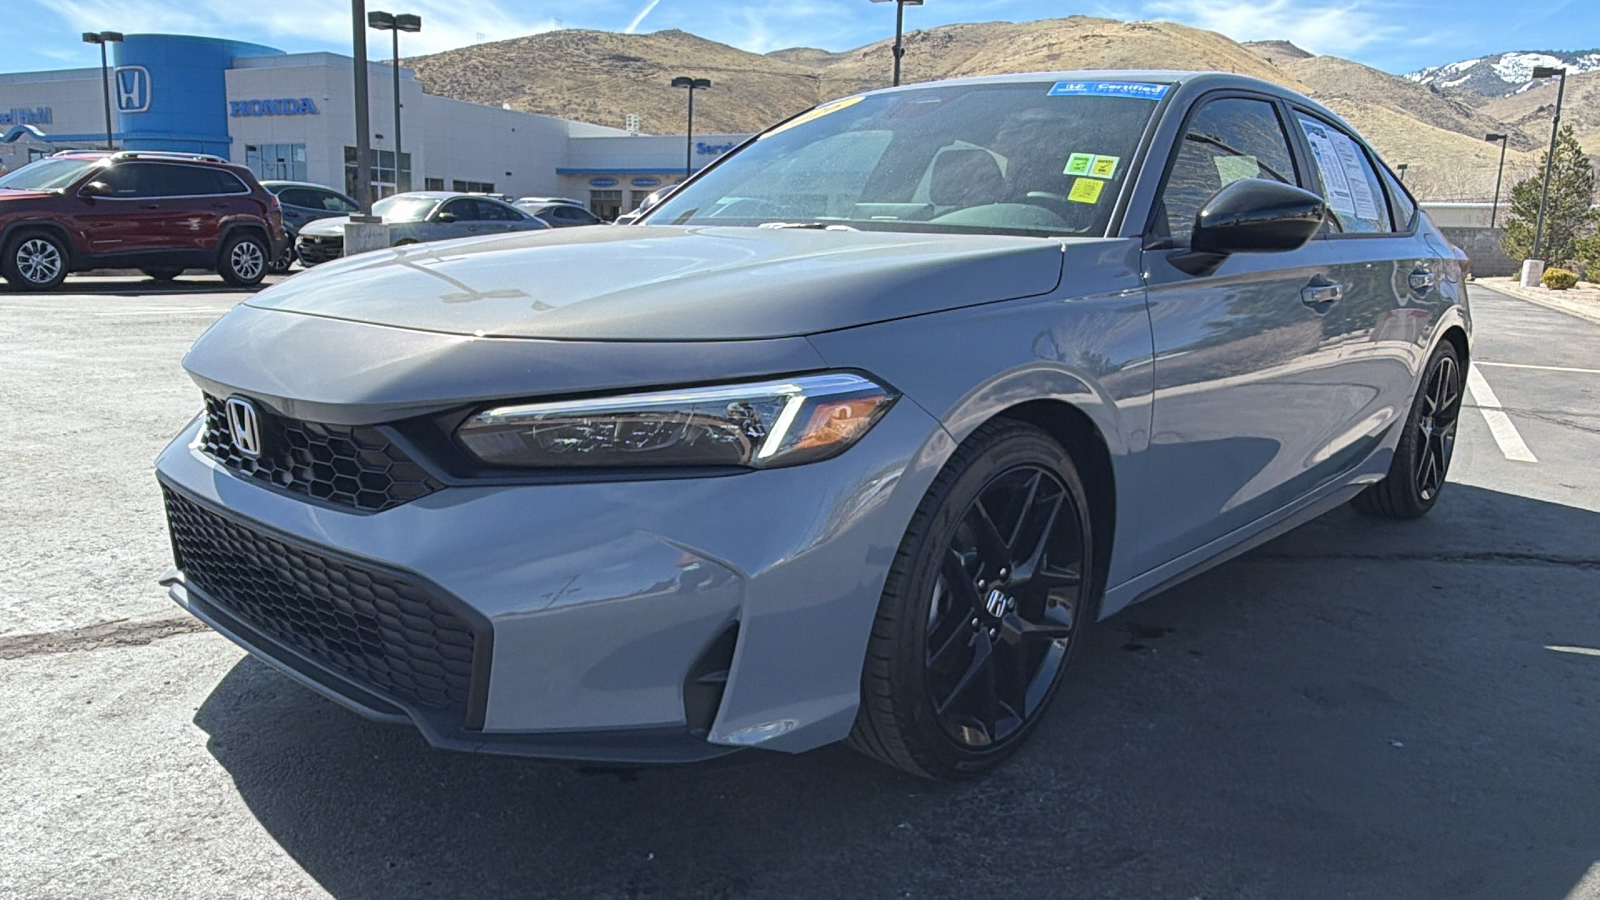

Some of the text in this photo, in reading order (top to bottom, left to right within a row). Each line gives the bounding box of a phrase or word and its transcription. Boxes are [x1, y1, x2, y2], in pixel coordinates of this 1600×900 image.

[1098, 83, 1164, 93] Certified
[229, 97, 320, 117] HONDA
[696, 142, 737, 155] Servi
